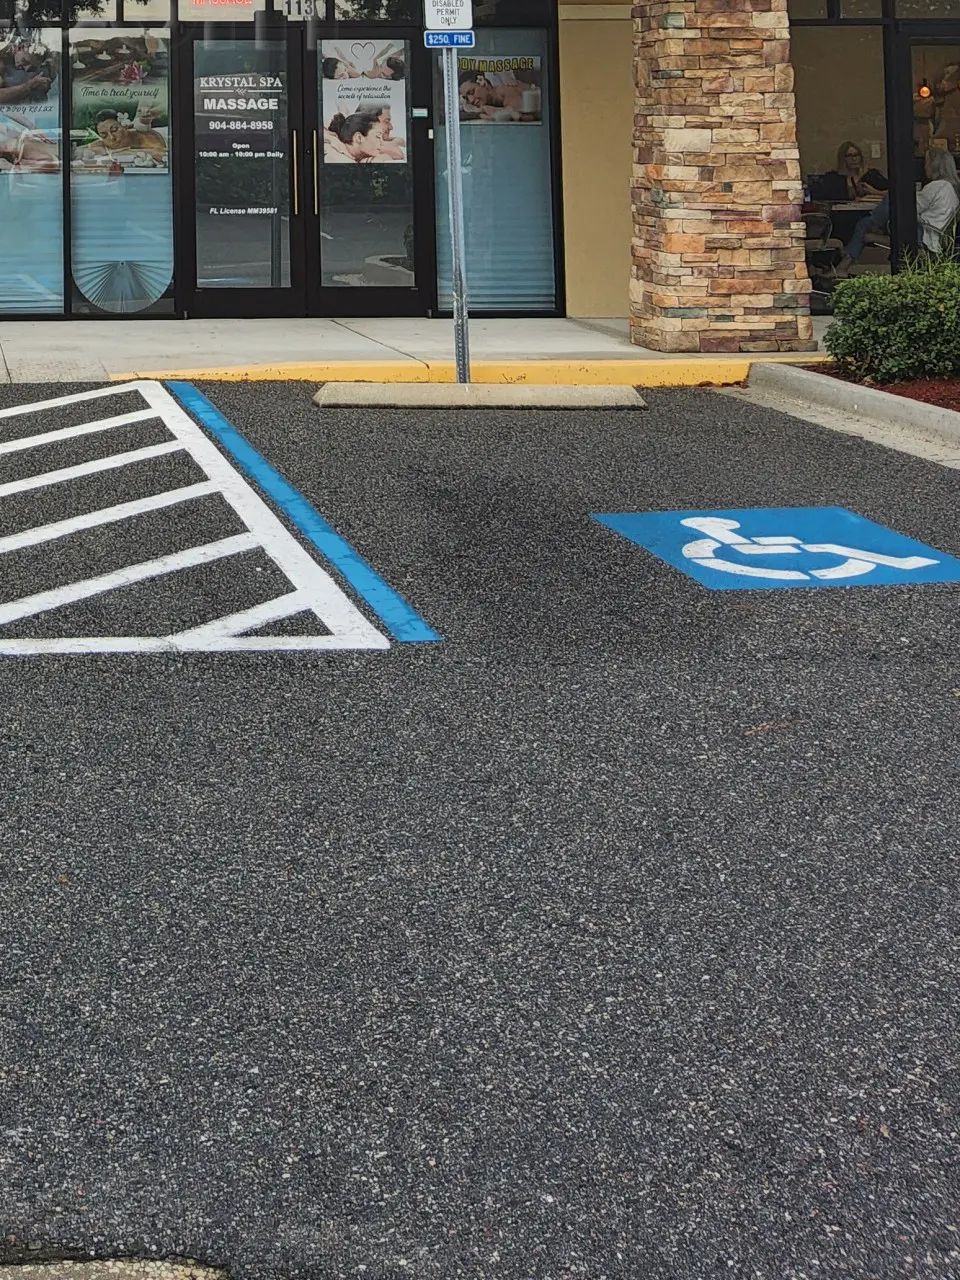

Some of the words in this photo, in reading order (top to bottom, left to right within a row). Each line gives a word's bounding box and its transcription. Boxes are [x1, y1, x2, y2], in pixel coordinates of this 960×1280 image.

[284, 0, 313, 16] 113
[432, 0, 464, 8] DISABLED
[436, 8, 460, 16] PERMIT
[440, 16, 457, 25] ONLY
[453, 33, 472, 44] FINE
[457, 56, 477, 71] DY
[478, 57, 534, 72] MASSAGE
[200, 77, 256, 87] KRYSTAL
[259, 77, 283, 87] SPA
[81, 86, 100, 97] Time
[100, 88, 109, 96] to
[109, 87, 129, 97] treat
[128, 88, 160, 100] yourself
[337, 84, 352, 93] Come
[382, 84, 392, 92] the
[203, 98, 279, 110] MASSAGE
[209, 121, 273, 130] 904-884-8958
[232, 142, 250, 150] Open
[266, 151, 284, 159] Daily
[209, 207, 219, 215] FL
[219, 207, 246, 215] License
